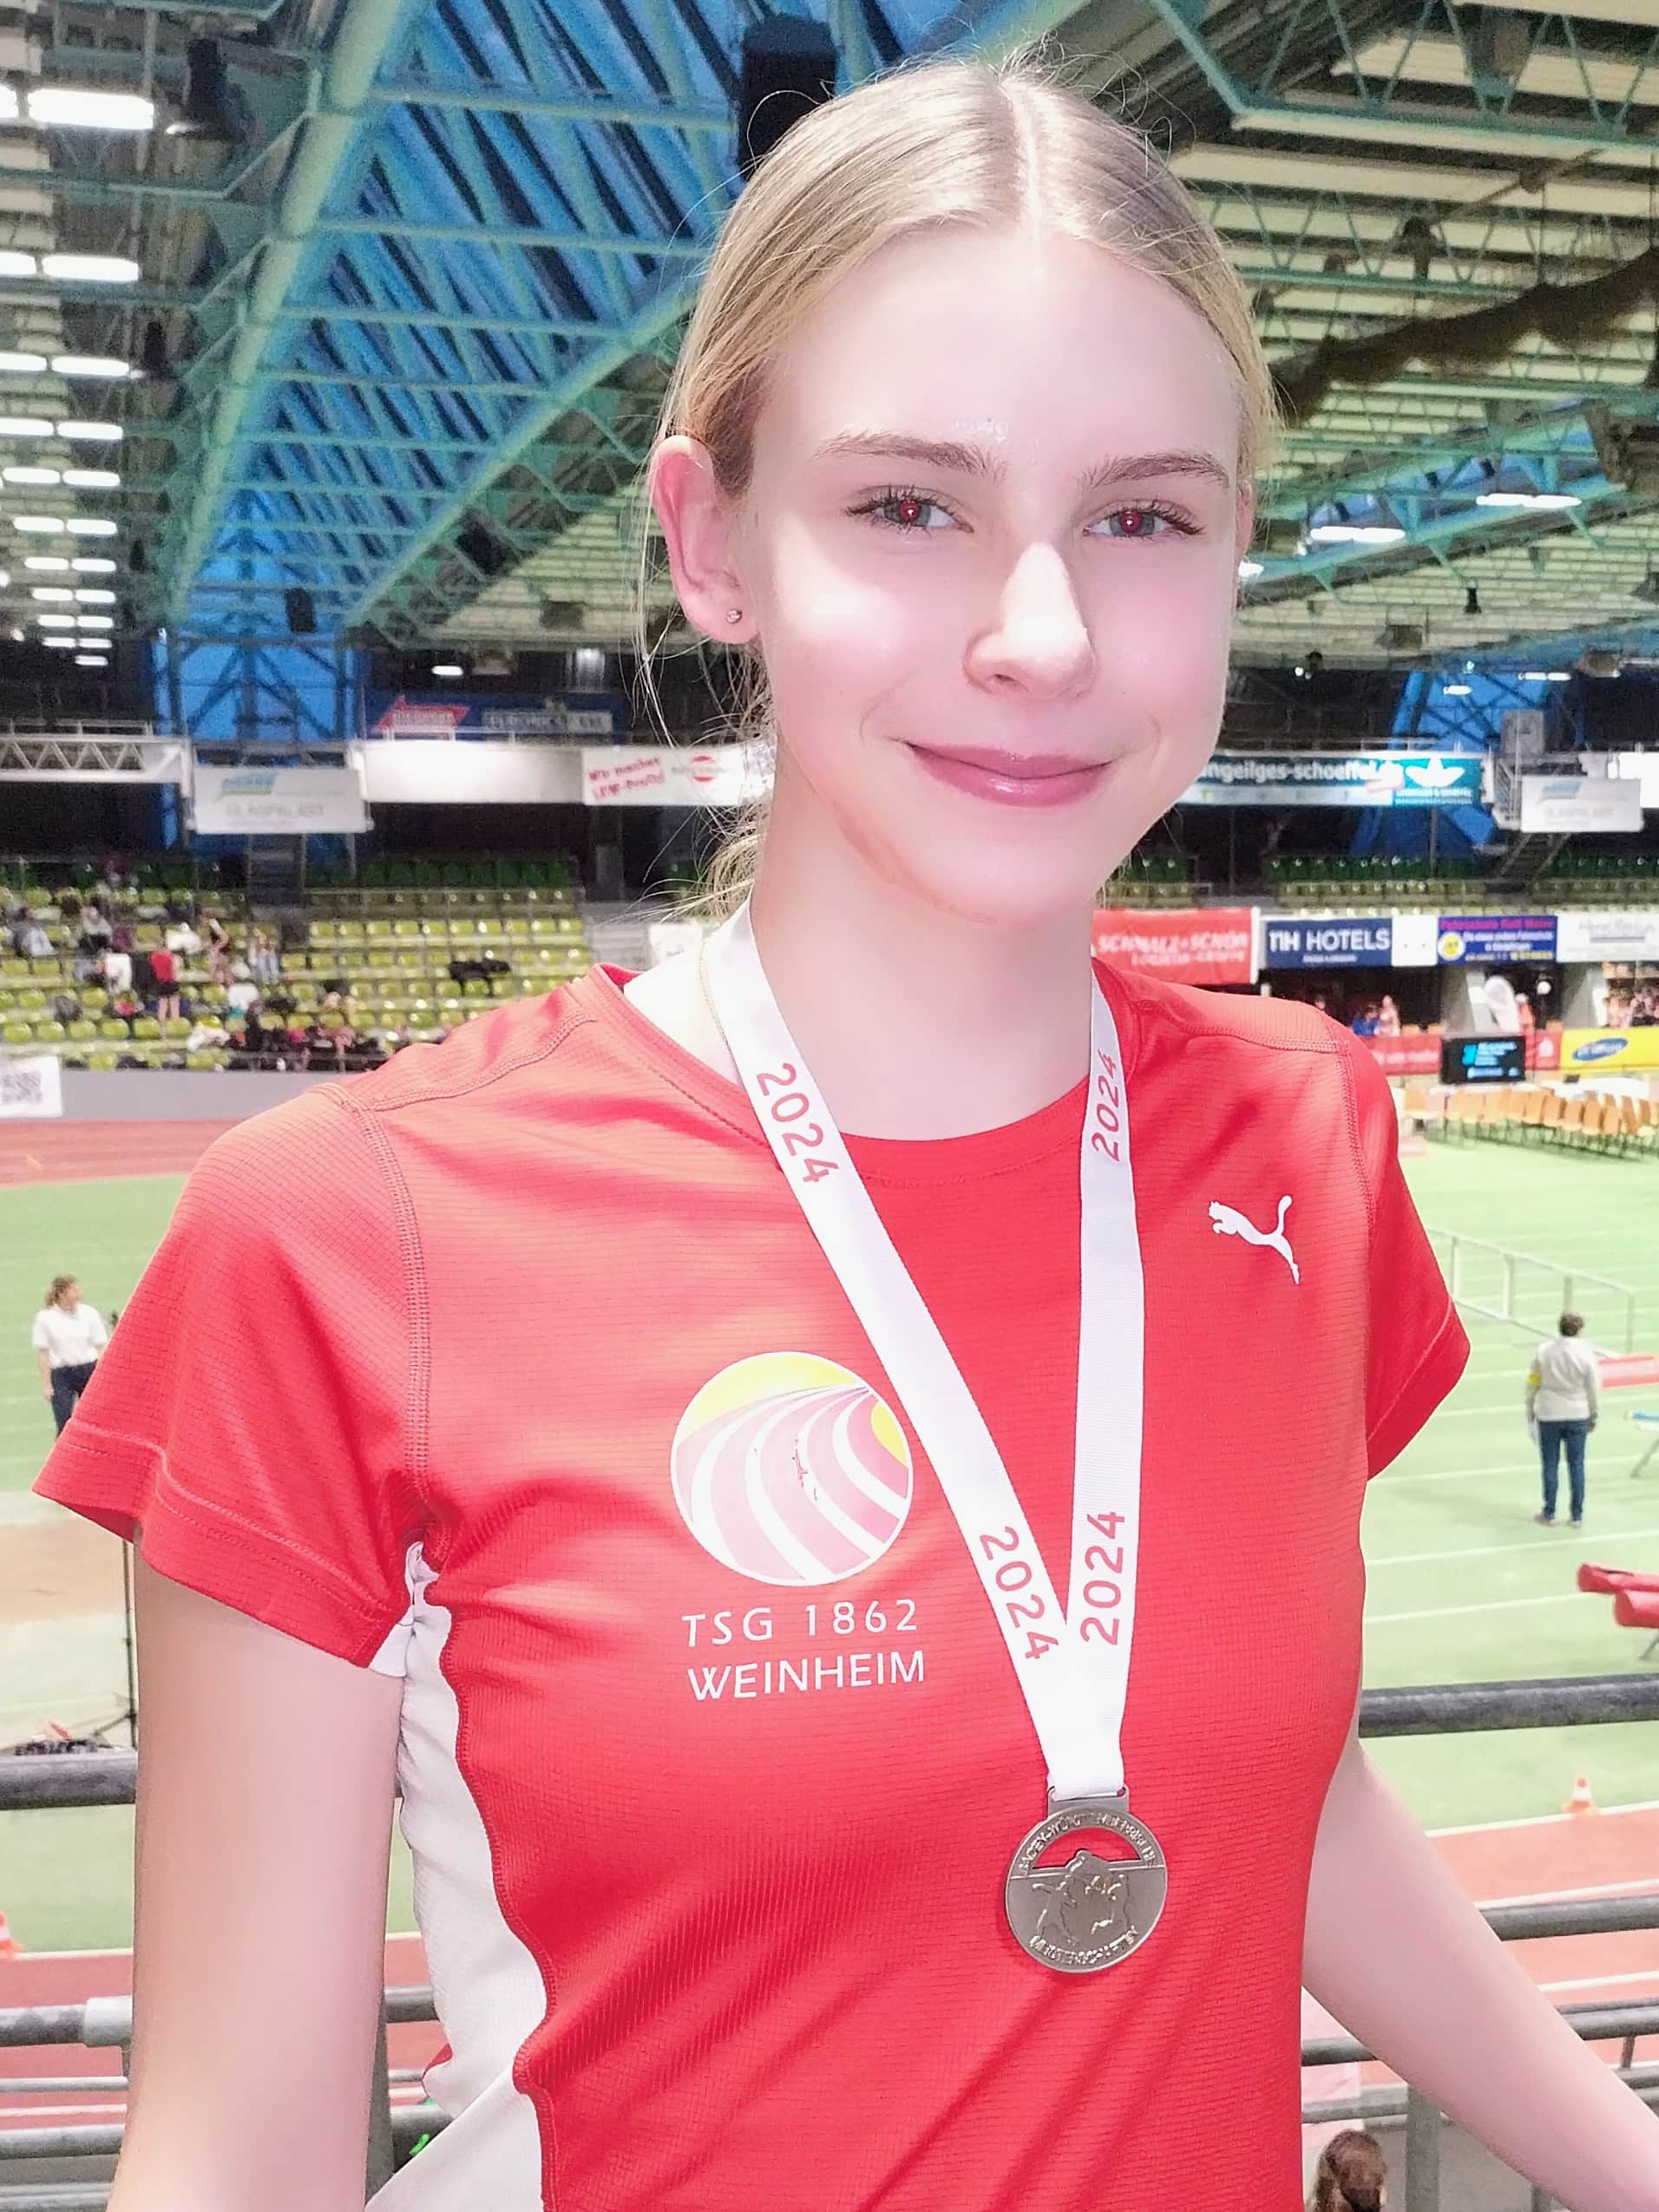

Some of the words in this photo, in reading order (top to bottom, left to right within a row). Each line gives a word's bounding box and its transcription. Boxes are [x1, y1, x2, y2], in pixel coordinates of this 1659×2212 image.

[1306, 928, 1390, 951] HOTELS
[757, 1061, 840, 1183] 2024
[1091, 1047, 1120, 1163] 2024
[681, 1607, 773, 1647] TSG
[804, 1598, 918, 1637] 1862
[979, 1525, 1059, 1660] 2024
[1079, 1511, 1125, 1646] 2024
[687, 1650, 925, 1702] WEINHEIM
